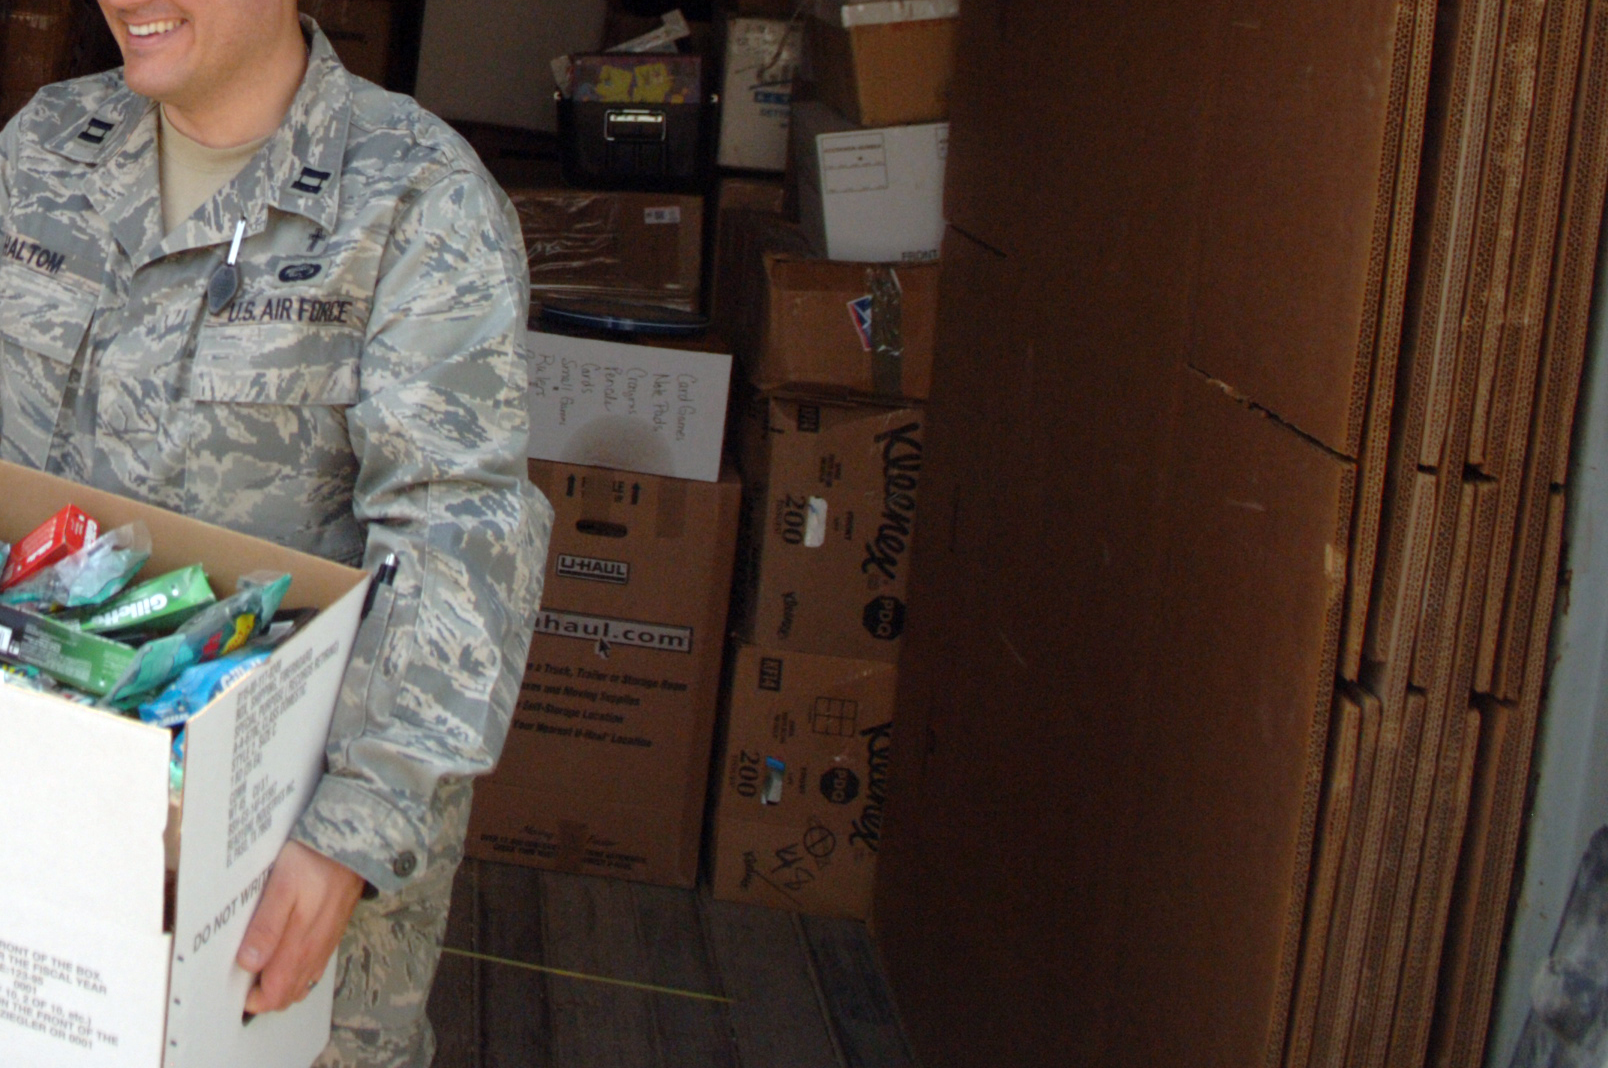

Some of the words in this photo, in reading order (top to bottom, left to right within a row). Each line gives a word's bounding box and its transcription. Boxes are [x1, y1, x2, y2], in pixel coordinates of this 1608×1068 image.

[3, 235, 66, 275] HALTOM
[228, 302, 255, 322] U.S.
[261, 300, 292, 322] AIR
[297, 298, 352, 323] FORCE
[559, 358, 577, 391] Small
[581, 363, 601, 394] Cards
[676, 374, 697, 402] Card
[652, 404, 668, 432] Pads
[862, 423, 922, 581] Kleenex
[782, 494, 806, 545] 200
[561, 557, 625, 575] U-HAUL
[544, 663, 573, 678] Truck,
[577, 667, 608, 682] Trailer
[621, 673, 659, 690] Storage
[544, 684, 562, 695] and
[563, 685, 598, 702] Moving
[600, 691, 641, 707] Supplies
[583, 708, 625, 724] Location
[536, 722, 573, 738] Nearest
[610, 736, 653, 748] Location
[737, 750, 760, 798] 200
[849, 721, 894, 852] Kleenex
[193, 924, 211, 953] DO
[214, 897, 238, 934] NOT
[8, 952, 30, 970] THE
[32, 961, 73, 985] FISCAL
[76, 976, 108, 997] YEAR
[32, 951, 48, 964] OF
[52, 956, 73, 973] THE
[32, 997, 49, 1010] OF
[12, 1001, 34, 1018] THE
[37, 1010, 75, 1032] FRONT
[77, 1024, 94, 1037] OF
[97, 1030, 120, 1049] THE
[50, 1026, 67, 1041] OR
